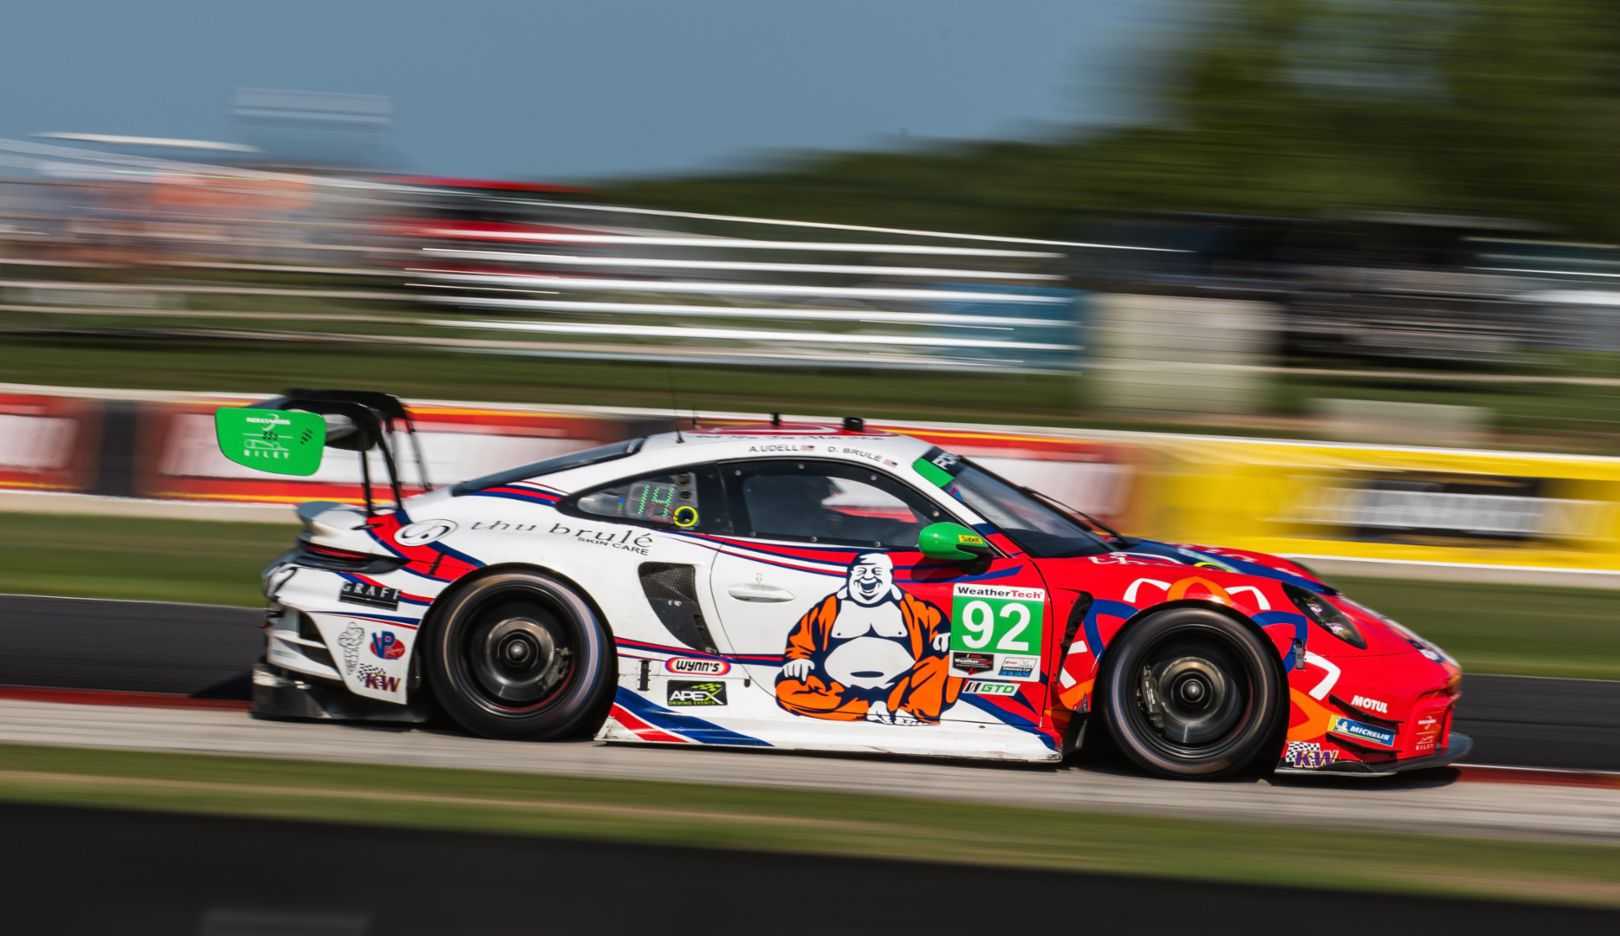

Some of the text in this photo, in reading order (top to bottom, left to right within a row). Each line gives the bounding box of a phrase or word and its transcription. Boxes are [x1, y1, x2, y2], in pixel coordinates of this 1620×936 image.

[547, 522, 654, 548] brulé
[577, 537, 650, 556] SKIN CARE
[341, 580, 401, 600] GRAFF
[958, 586, 1041, 599] WeatherTech
[961, 600, 1031, 652] 92
[371, 630, 396, 660] VP
[364, 672, 402, 693] KW
[980, 683, 1016, 694] GTD
[669, 687, 724, 704] APEX
[1351, 695, 1387, 714] MOTUL
[1350, 726, 1390, 740] MICHELIN
[1293, 750, 1340, 768] KW
